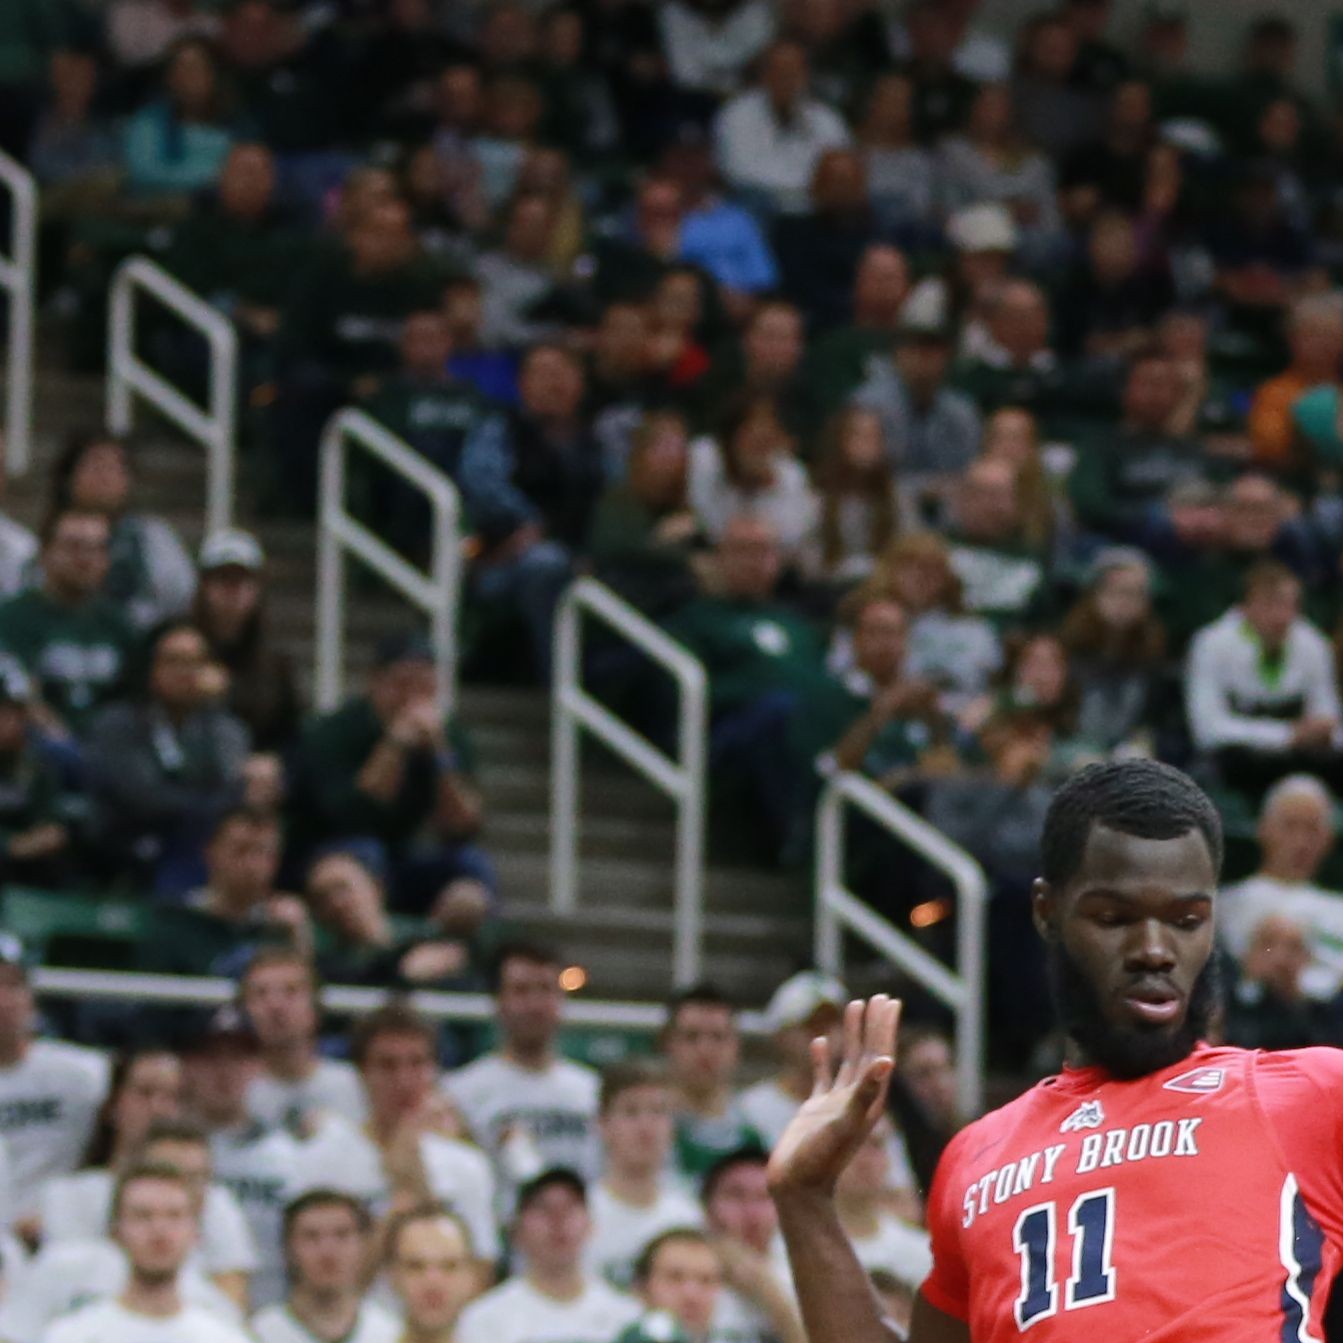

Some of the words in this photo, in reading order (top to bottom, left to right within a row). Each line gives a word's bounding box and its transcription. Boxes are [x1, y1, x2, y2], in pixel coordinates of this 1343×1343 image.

[962, 1142, 1065, 1229] STONY
[1076, 1117, 1202, 1173] BROOK
[1012, 1186, 1117, 1333] 11
